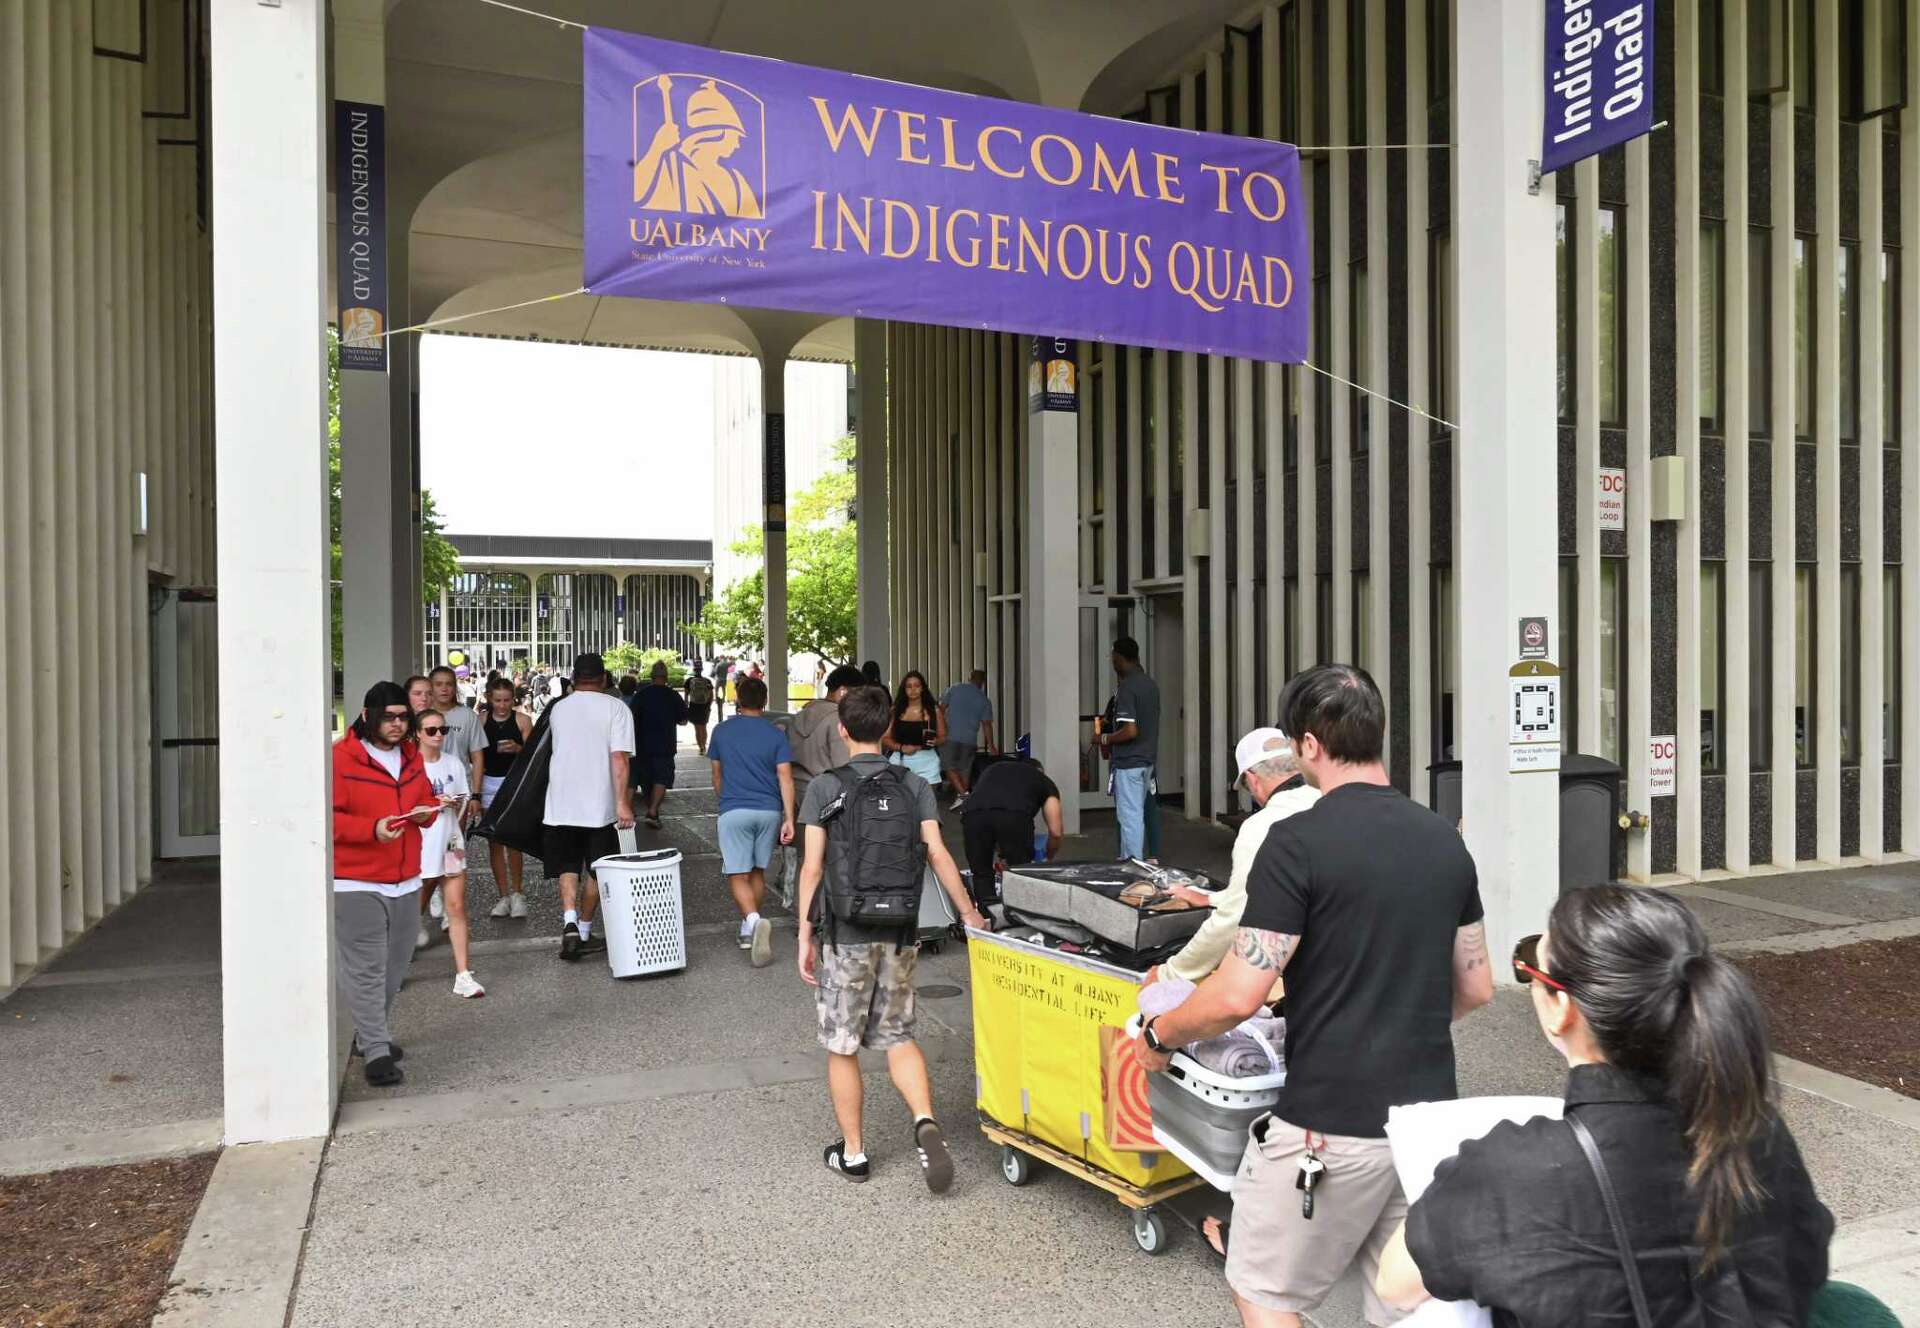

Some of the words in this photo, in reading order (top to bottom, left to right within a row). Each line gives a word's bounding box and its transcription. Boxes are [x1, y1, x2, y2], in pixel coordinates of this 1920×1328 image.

[1603, 4, 1644, 121] Quad
[352, 112, 371, 237] INDIGENOUS
[809, 97, 1185, 205] WELCOME
[1200, 163, 1287, 223] TO
[630, 217, 772, 251] UALBANY
[632, 248, 656, 262] State
[657, 251, 705, 265] University
[708, 254, 718, 264] of
[722, 254, 741, 266] New
[746, 256, 767, 269] York
[811, 190, 1152, 290] INDIGENOUS
[1167, 241, 1293, 312] QUAD
[350, 241, 371, 301] QUAD
[1650, 766, 1674, 776] ohawk
[978, 947, 1043, 980] UNIVERSITY
[1051, 971, 1065, 986] AT
[1073, 982, 1122, 1007] ALBANY
[1074, 1001, 1107, 1026] LIFE
